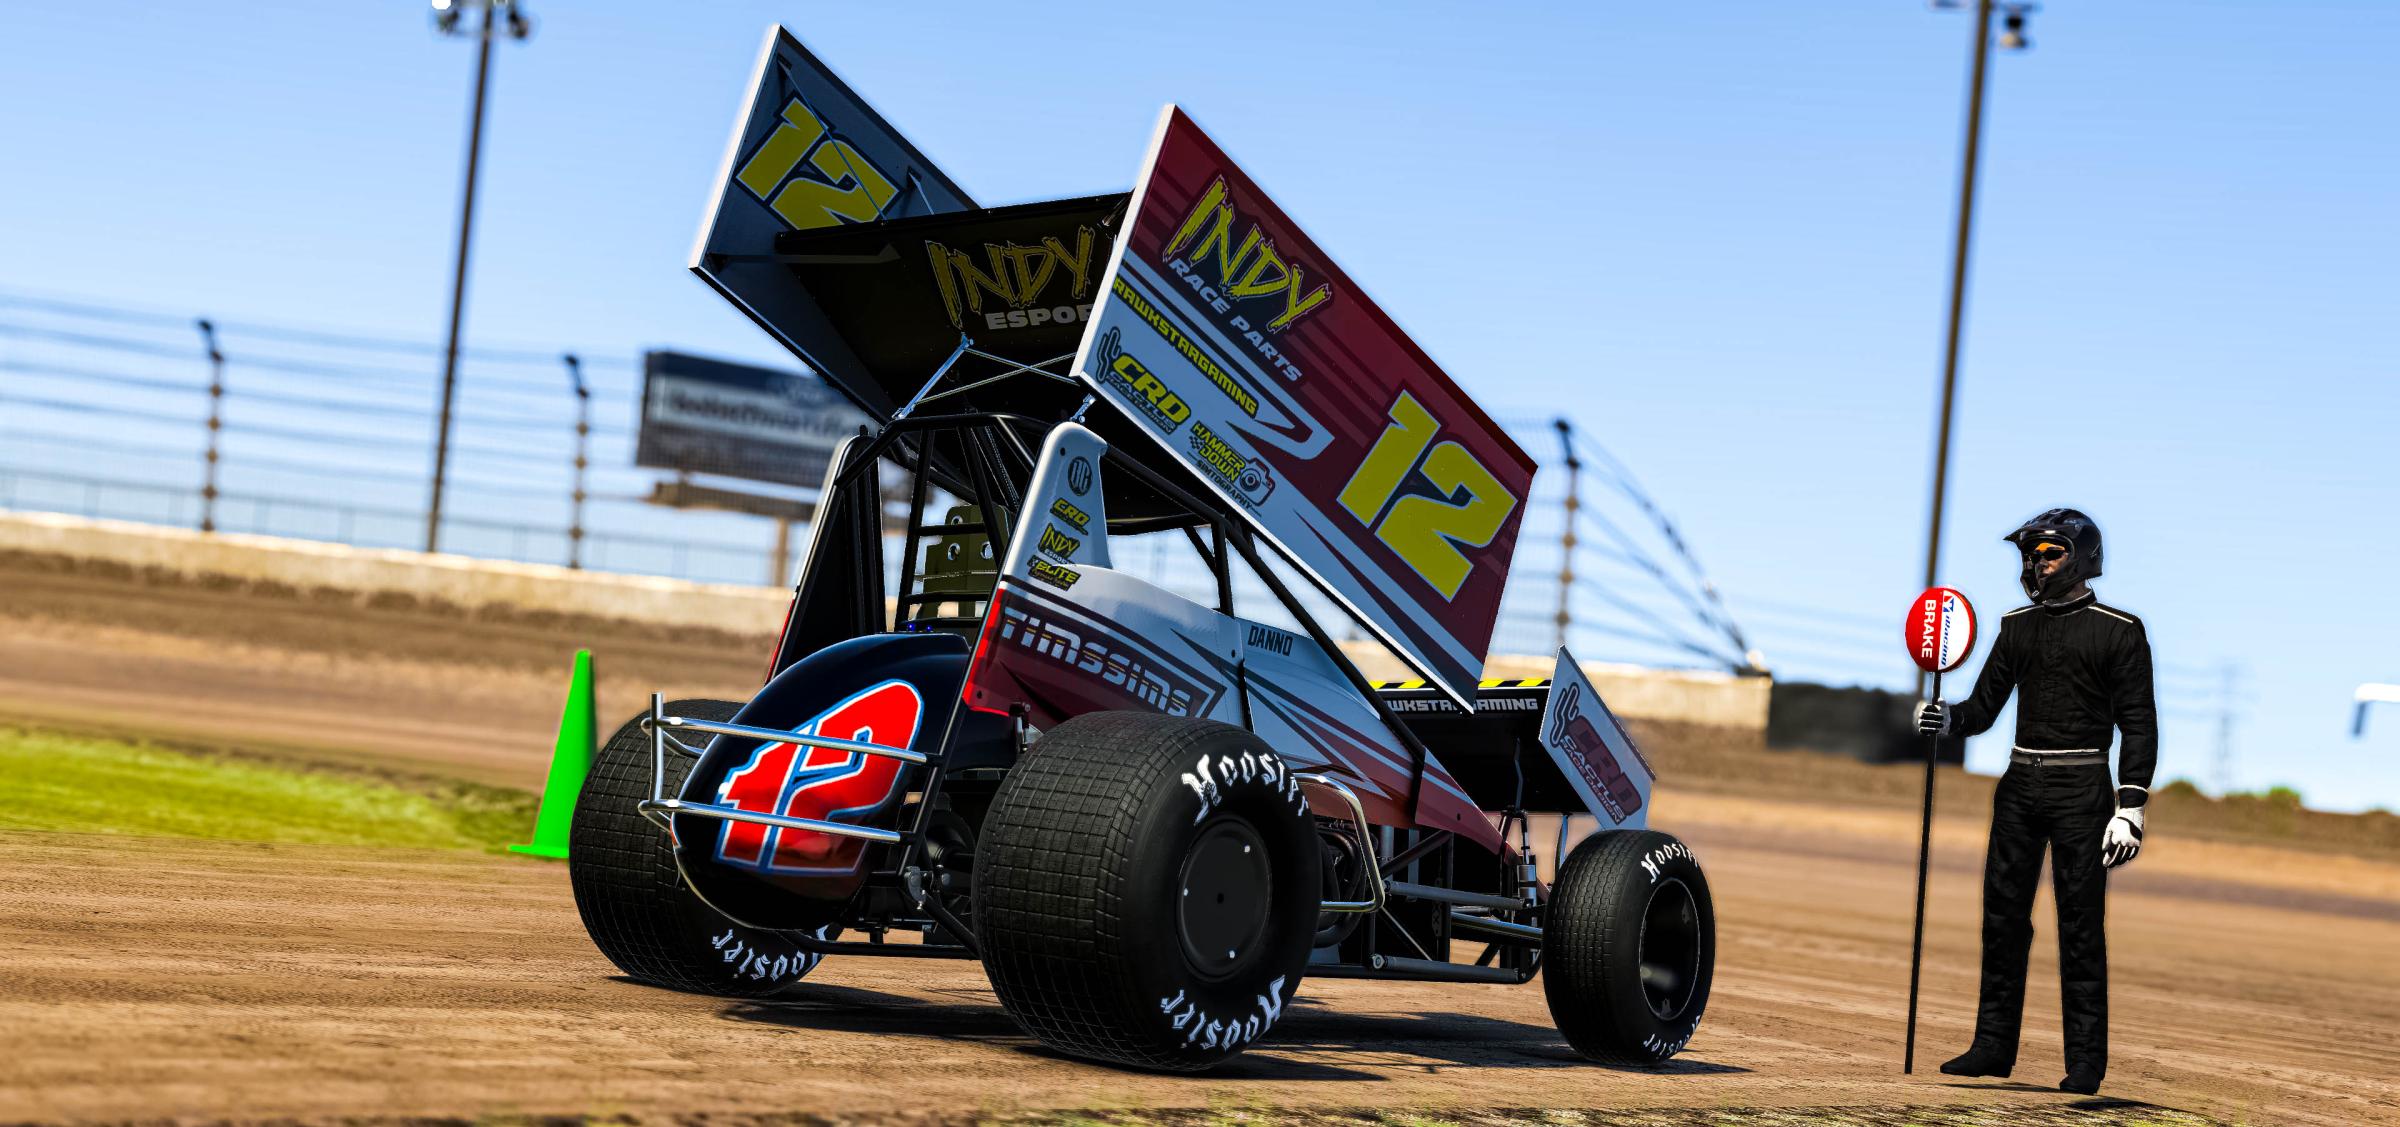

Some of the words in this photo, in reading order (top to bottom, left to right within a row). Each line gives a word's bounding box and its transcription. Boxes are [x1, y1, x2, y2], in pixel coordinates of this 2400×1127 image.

[735, 94, 900, 230] 12
[925, 225, 1095, 330] INDY
[1162, 174, 1332, 334] INDY
[1169, 258, 1229, 316] RACE
[1230, 315, 1303, 383] PARTS
[1112, 354, 1192, 424] CRD
[1192, 422, 1246, 471] HAMMER
[1200, 445, 1240, 481] DOWN
[1336, 389, 1519, 604] 12
[1036, 561, 1080, 583] ELITE
[1247, 625, 1293, 657] DANNO
[1921, 599, 1937, 658] BRAKE
[713, 679, 923, 876] 12
[1181, 750, 1309, 826] Hoosier
[1563, 735, 1626, 820] CACTUS
[1567, 715, 1643, 816] CRD
[1160, 974, 1287, 1051] Hoosier
